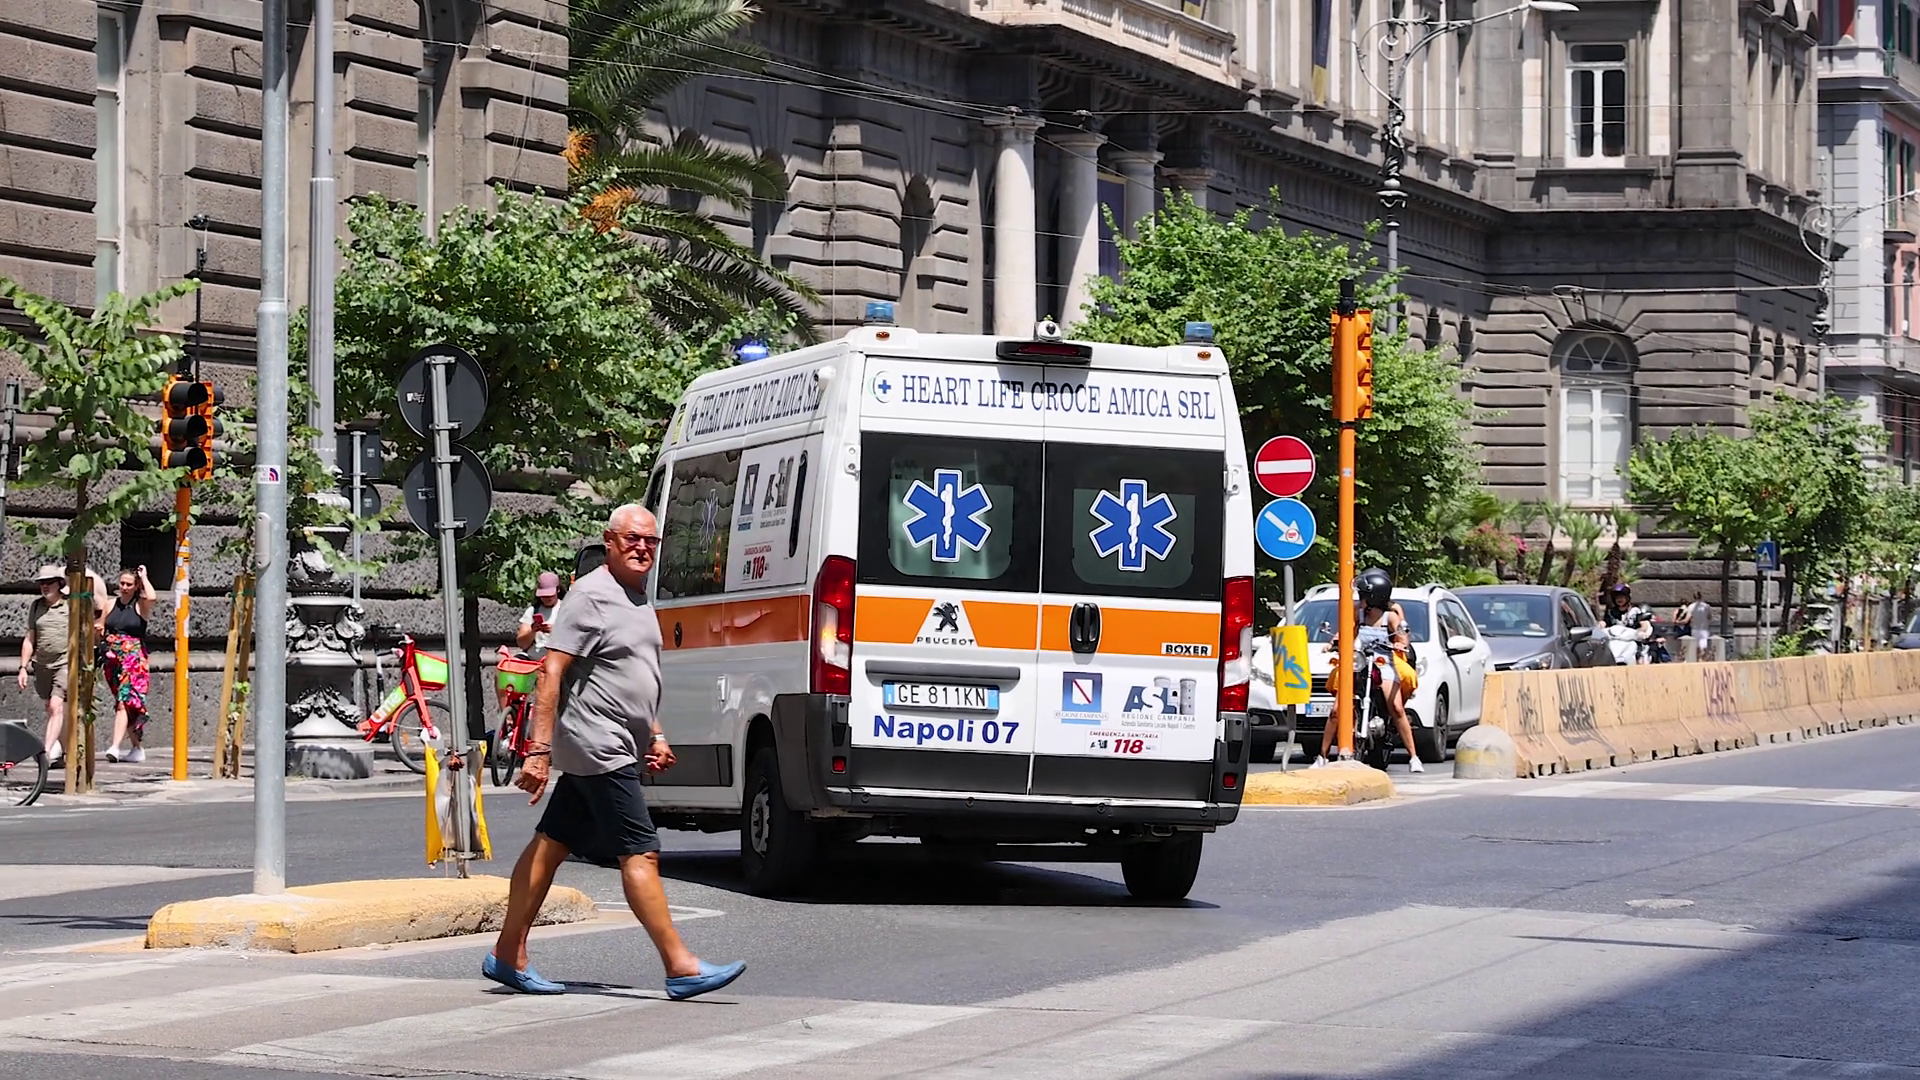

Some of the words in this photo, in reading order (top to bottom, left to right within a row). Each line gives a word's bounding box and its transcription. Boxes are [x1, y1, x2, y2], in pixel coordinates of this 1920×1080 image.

[902, 375, 971, 406] HEART
[977, 379, 1024, 409] LIFE
[1031, 381, 1100, 413] CROCE
[1107, 387, 1172, 417] AMICA
[1178, 390, 1216, 420] SRL
[751, 556, 765, 580] 118
[916, 637, 975, 646] PEUGEOT
[1165, 644, 1209, 656] BOXER
[898, 684, 920, 704] GE
[928, 686, 986, 707] 811KN
[1123, 686, 1177, 714] ASL
[873, 715, 974, 745] Napoli
[982, 720, 1019, 744] 07
[1090, 730, 1125, 738] EMERGENZA
[1127, 731, 1159, 739] SANITARIA
[1114, 739, 1144, 754] 118
